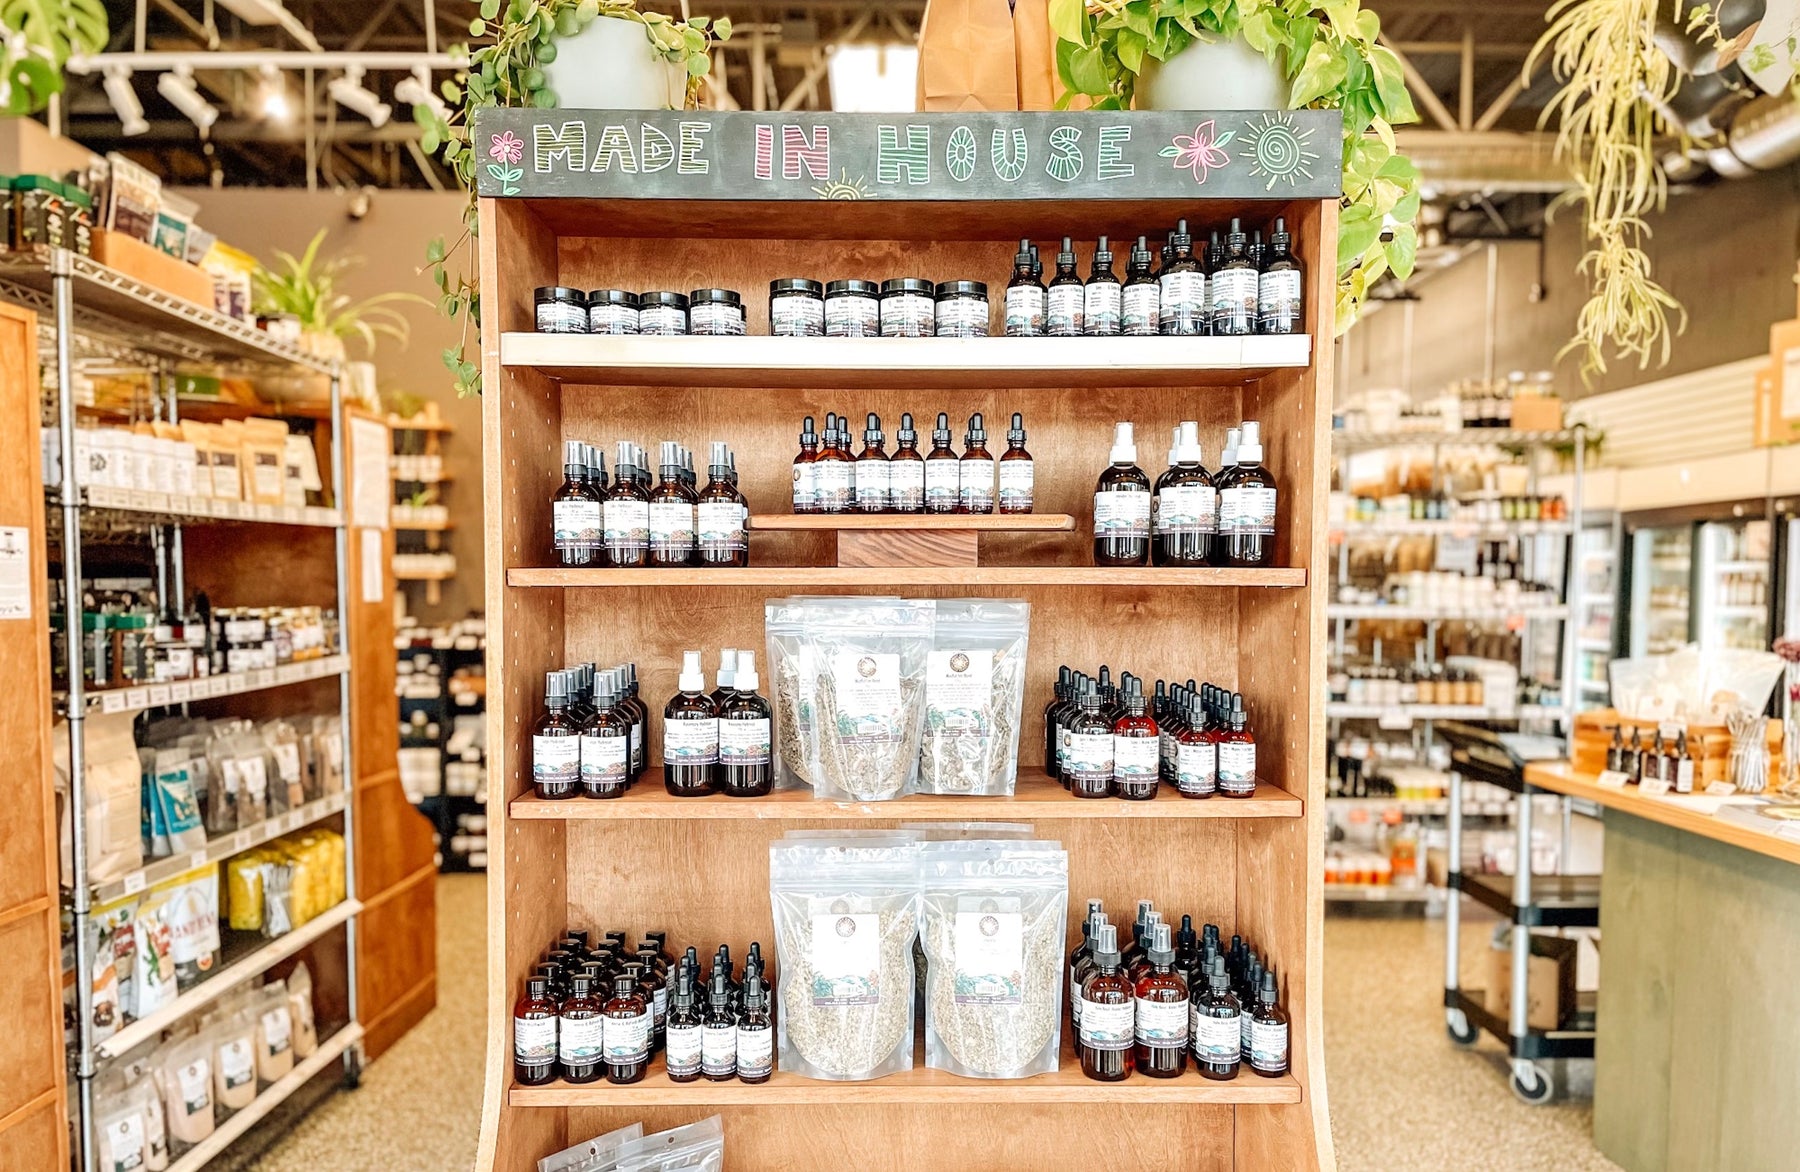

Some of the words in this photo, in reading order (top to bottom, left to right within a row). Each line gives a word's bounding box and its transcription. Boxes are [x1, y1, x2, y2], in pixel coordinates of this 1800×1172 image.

[533, 121, 711, 174] MADE
[755, 124, 830, 180] IN
[877, 125, 1134, 184] HOUSE
